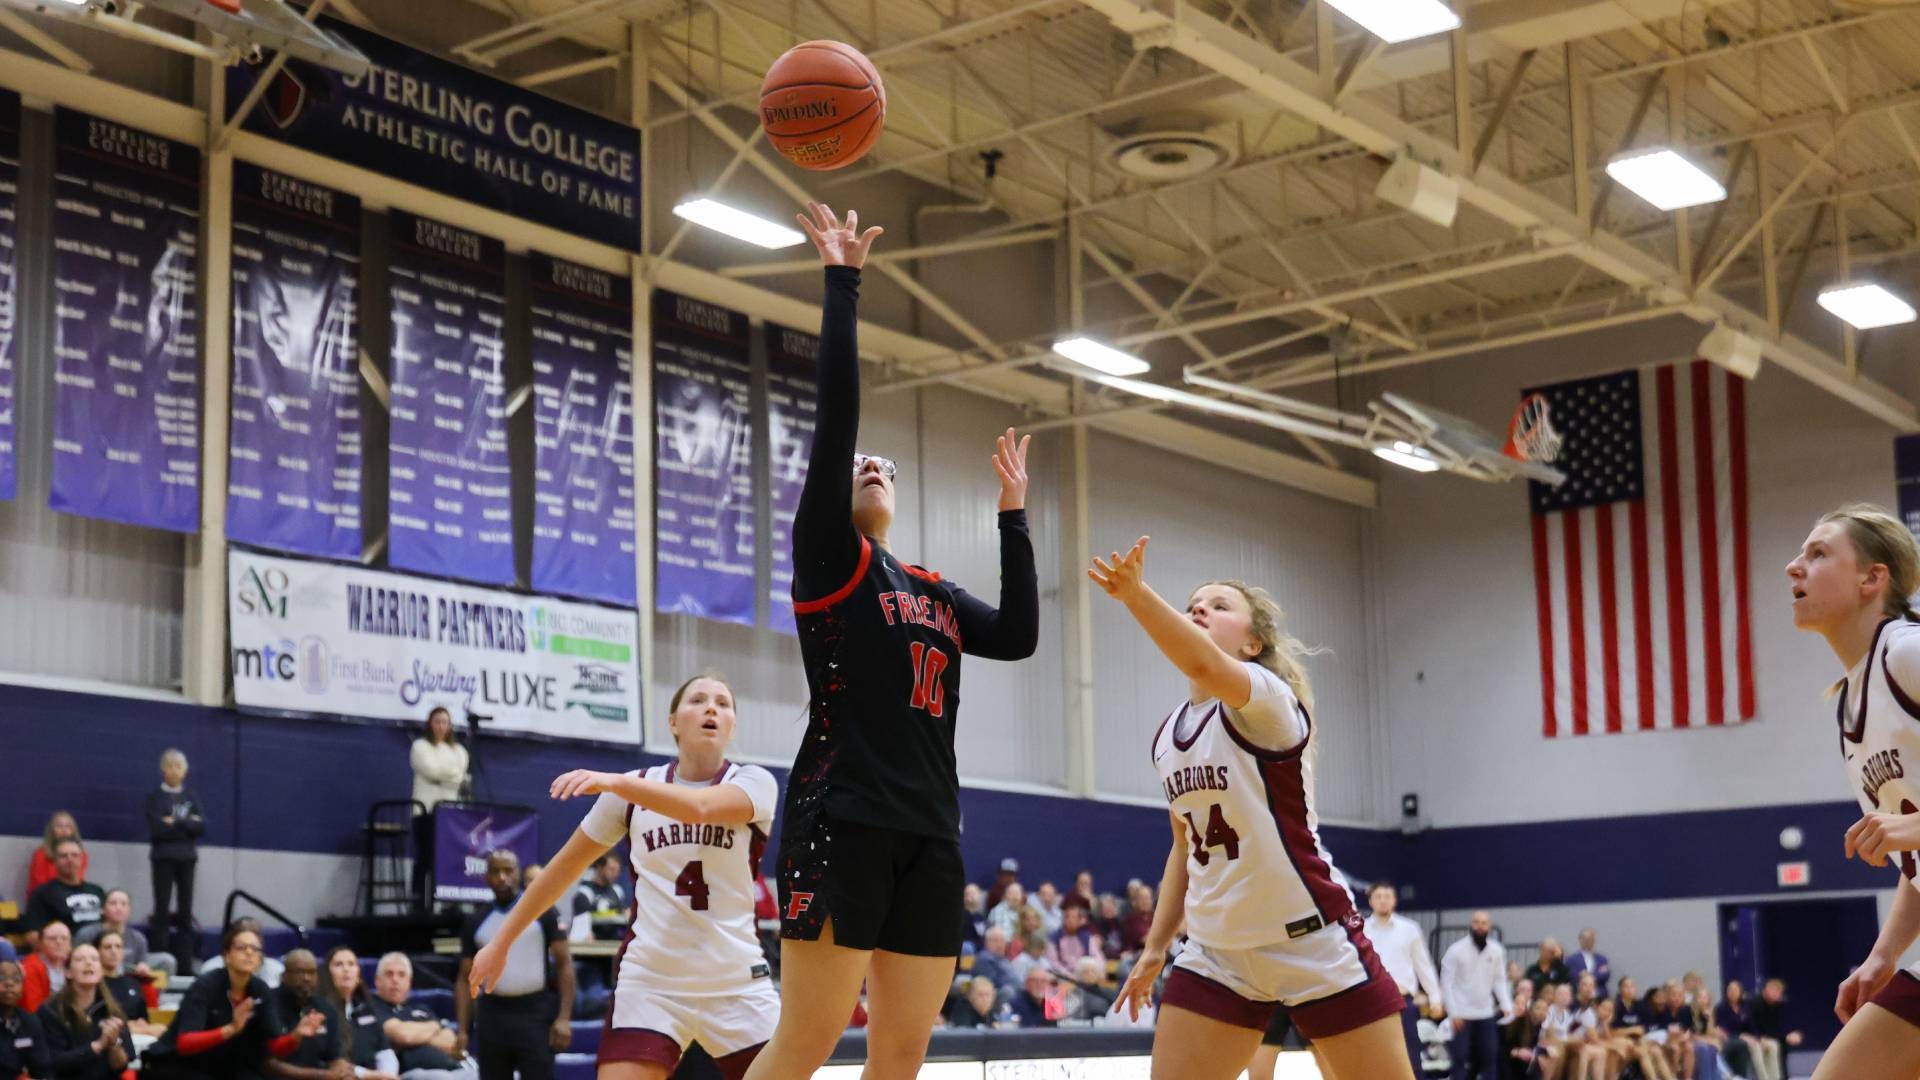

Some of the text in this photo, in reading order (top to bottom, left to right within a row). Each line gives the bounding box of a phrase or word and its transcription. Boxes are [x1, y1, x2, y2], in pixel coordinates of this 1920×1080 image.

[341, 103, 634, 219] ATHLETIC HALL OF FAME
[347, 584, 430, 641] WARRIOR
[438, 598, 526, 653] PARTNERS
[233, 644, 296, 681] mtc
[331, 656, 395, 684] First Bank
[400, 659, 477, 712] Sterling
[910, 641, 949, 717] 10
[481, 669, 557, 712] LUXE
[1163, 765, 1228, 804] ARRIORS
[642, 823, 735, 853] WARRIORS
[1182, 803, 1240, 867] 14
[675, 860, 710, 911] 4
[786, 891, 814, 920] F
